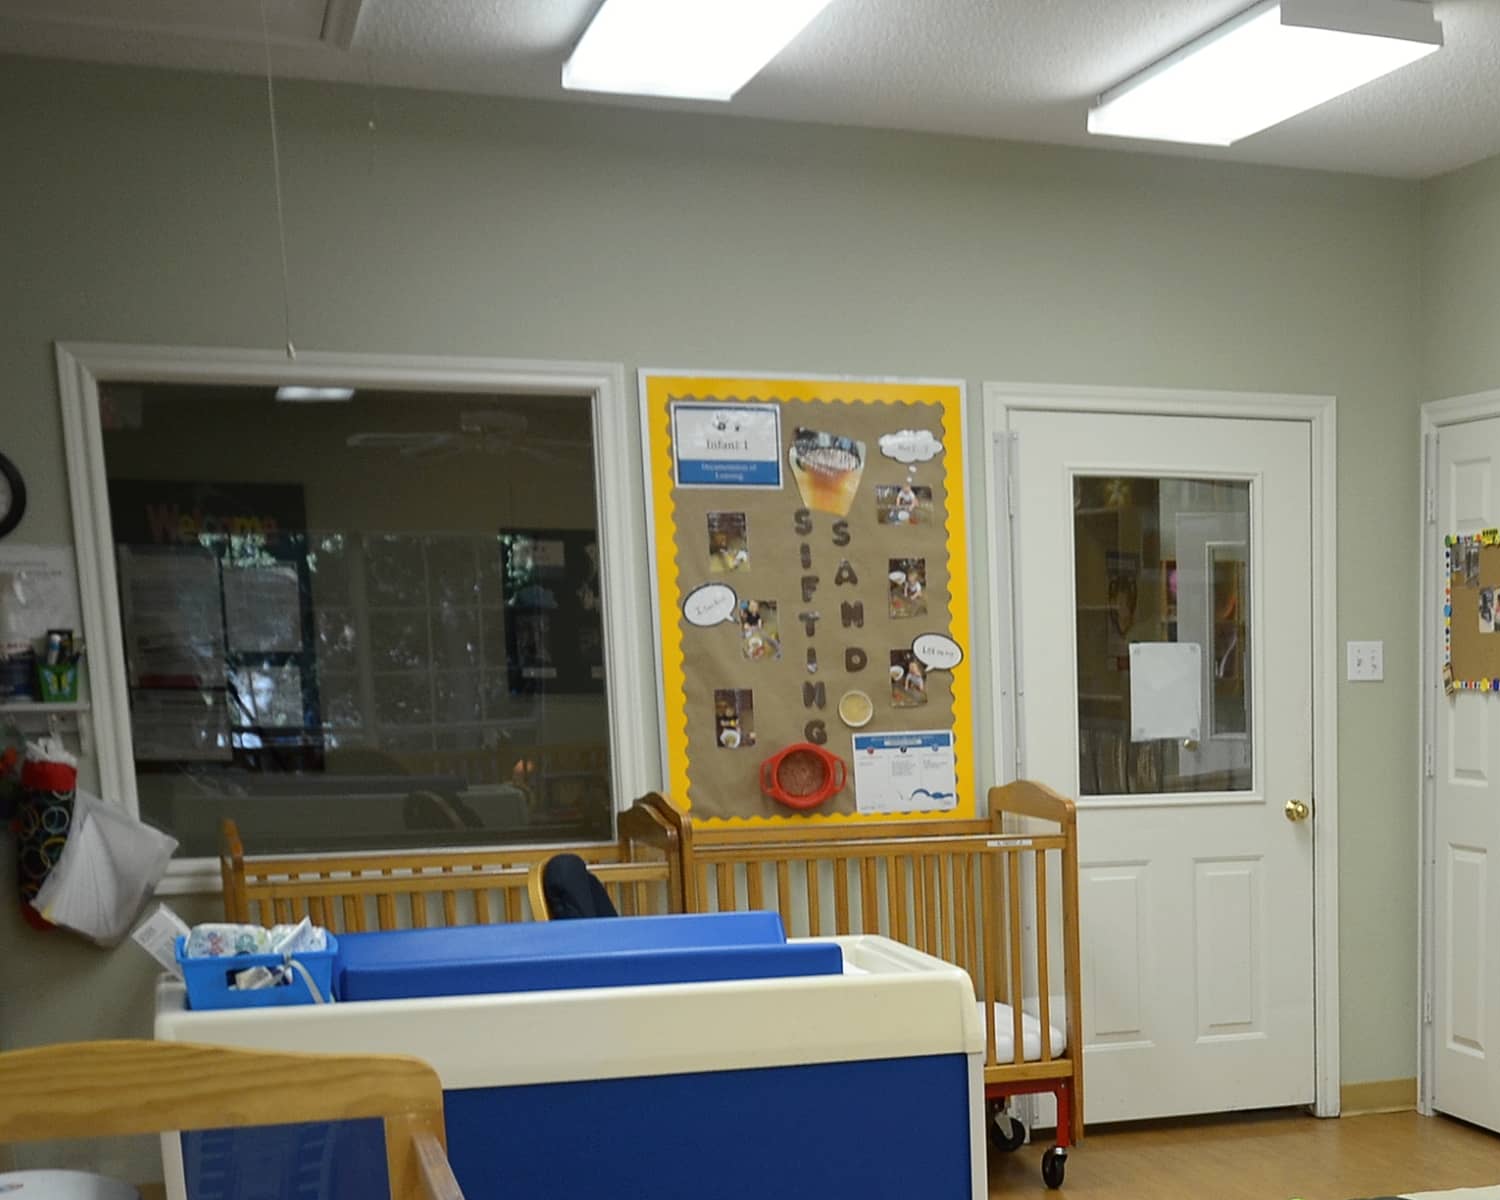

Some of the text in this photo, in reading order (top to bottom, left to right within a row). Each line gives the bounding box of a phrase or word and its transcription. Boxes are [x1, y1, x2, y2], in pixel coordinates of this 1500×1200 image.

[706, 439, 738, 450] Infant
[794, 508, 827, 744] SIFTING
[832, 520, 868, 672] SAND
